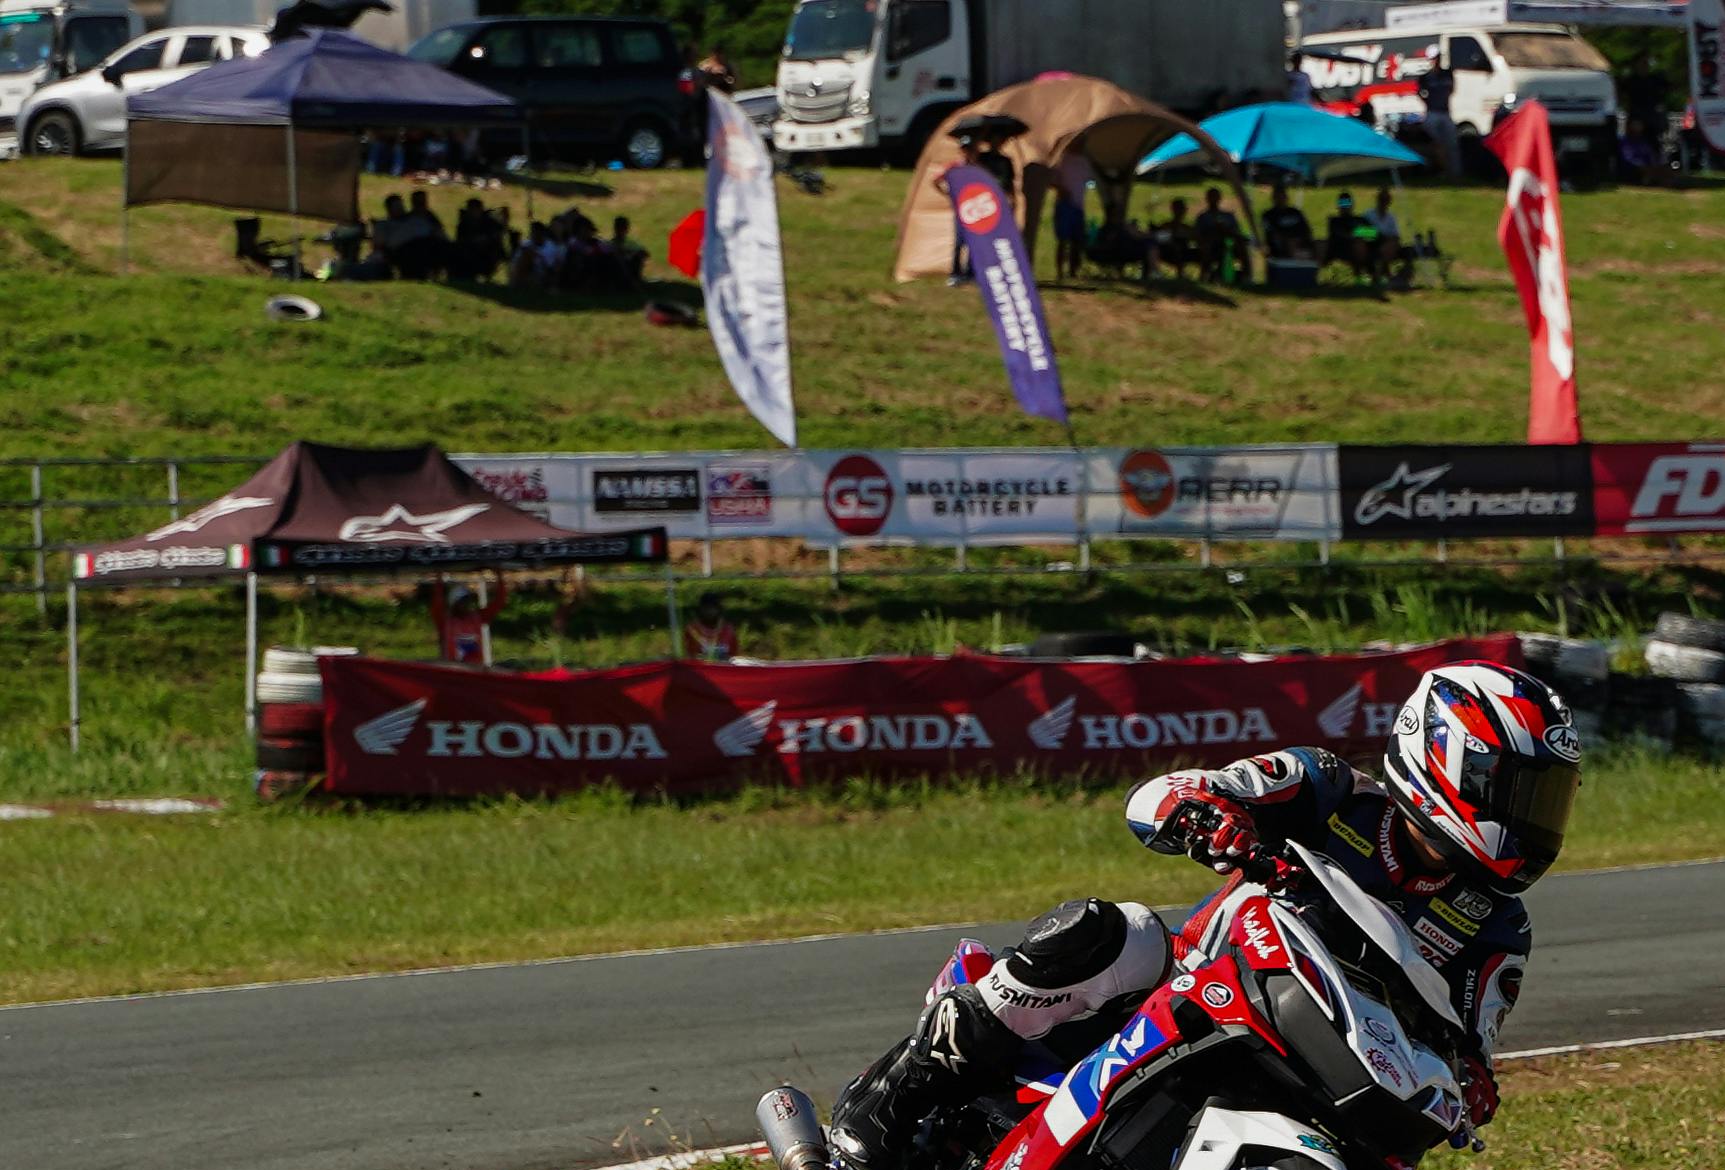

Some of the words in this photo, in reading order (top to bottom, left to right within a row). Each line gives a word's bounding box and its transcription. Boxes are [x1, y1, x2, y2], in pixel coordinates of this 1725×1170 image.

[827, 477, 890, 518] GS
[906, 476, 1071, 498] MOTORCYCLE
[1411, 488, 1578, 520] alpinestars
[933, 498, 1038, 518] BATTERY
[426, 719, 670, 760] HONDA
[775, 711, 993, 754] HONDA
[1080, 706, 1278, 750] HONDA
[1332, 820, 1372, 852] DUNLOP
[989, 972, 1073, 1009] KUSHITANI
